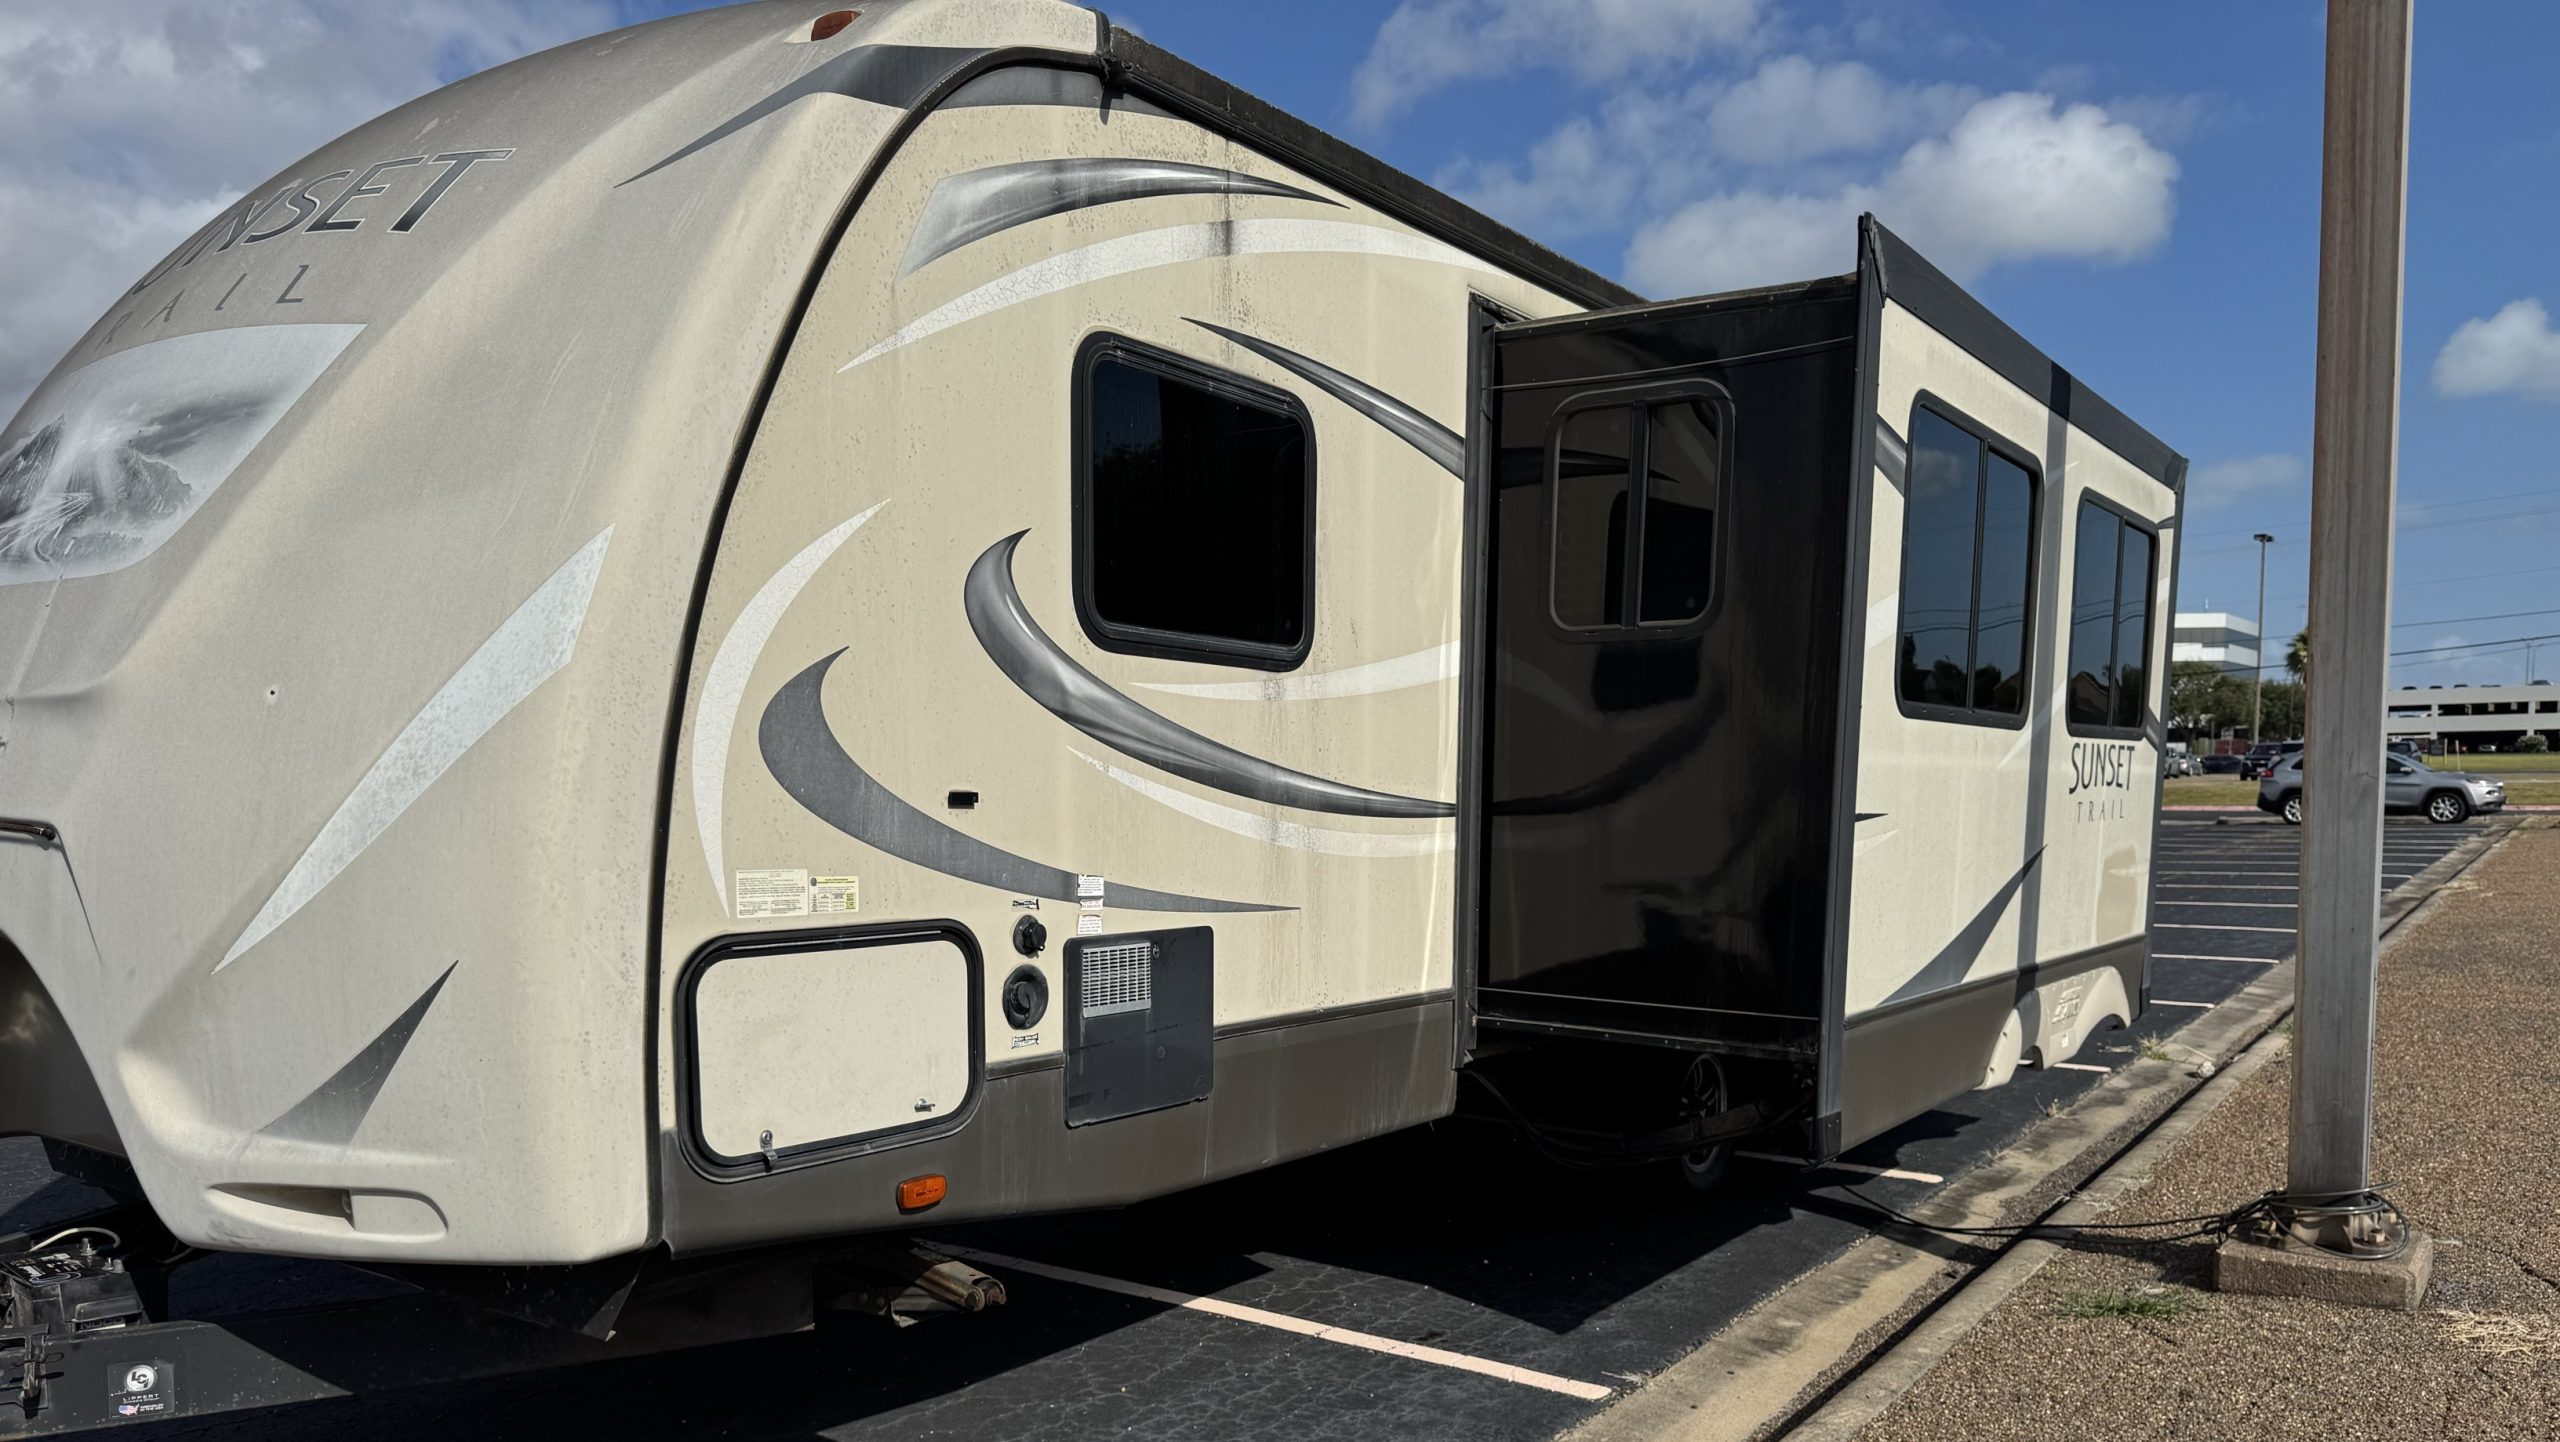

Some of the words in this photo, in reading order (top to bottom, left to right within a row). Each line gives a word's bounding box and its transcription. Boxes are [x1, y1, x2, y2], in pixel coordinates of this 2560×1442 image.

[131, 147, 518, 296] UNSET
[92, 263, 310, 349] RAIL
[2069, 742, 2135, 795] SUNSET
[2077, 799, 2124, 824] TRAIL
[123, 1393, 159, 1402] LIPPERT
